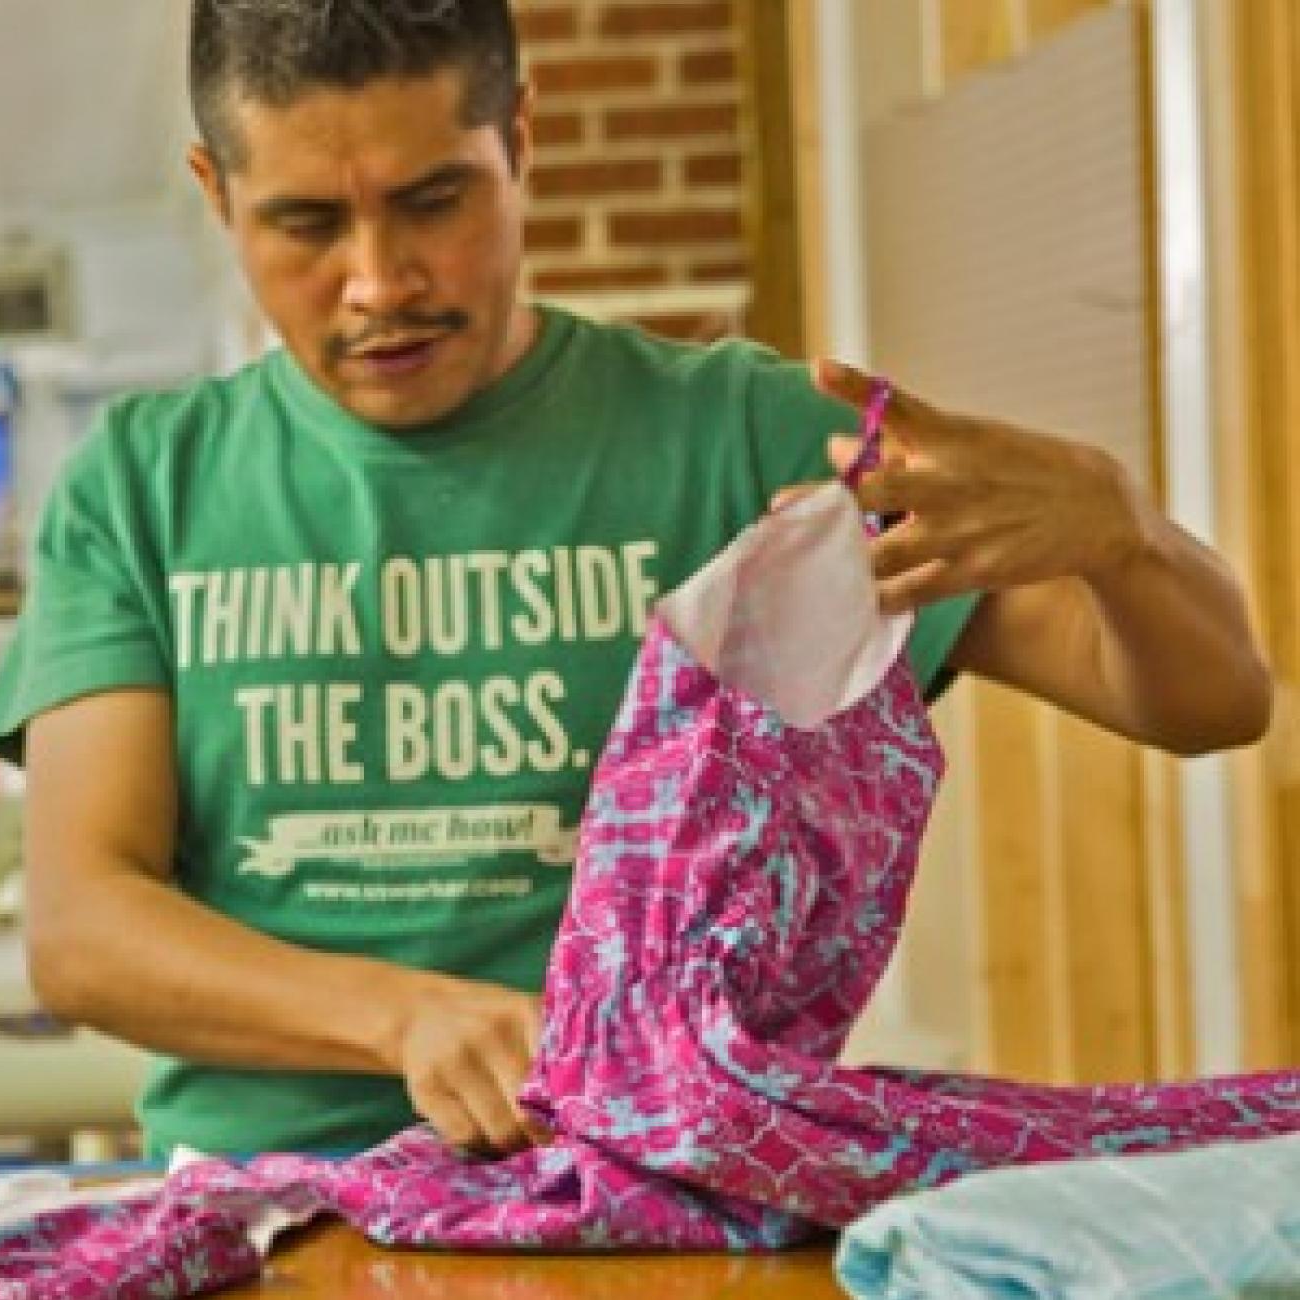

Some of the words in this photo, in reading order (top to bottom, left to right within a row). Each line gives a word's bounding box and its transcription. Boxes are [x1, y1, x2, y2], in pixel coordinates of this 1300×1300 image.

[168, 559, 363, 670] THINK
[380, 540, 661, 658] OUTSIDE
[233, 683, 365, 786] THE
[384, 670, 592, 782] BOSS.
